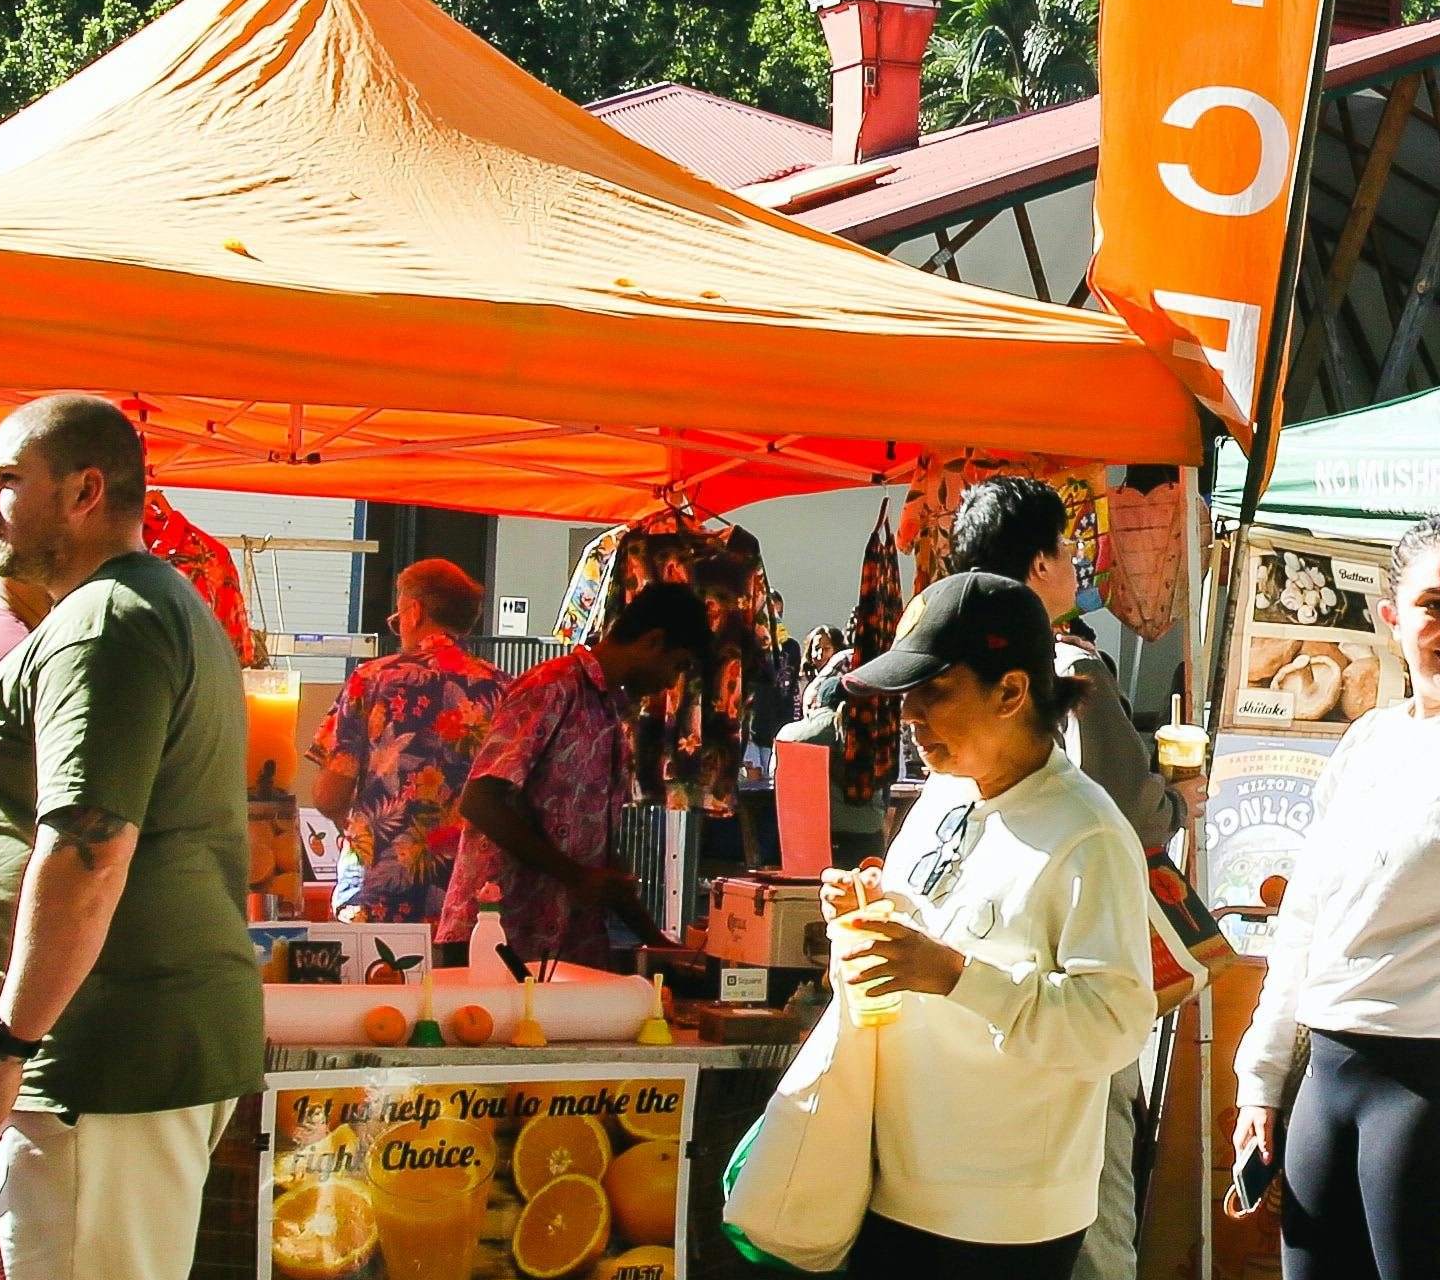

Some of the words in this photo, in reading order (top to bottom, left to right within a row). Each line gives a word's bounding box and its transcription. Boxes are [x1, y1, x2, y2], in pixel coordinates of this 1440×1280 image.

[1313, 460, 1352, 497] NO
[1237, 776, 1298, 797] MILTON
[380, 1090, 442, 1131] help
[449, 1087, 513, 1120] You
[515, 1090, 544, 1117] to
[548, 1086, 631, 1118] make
[636, 1085, 680, 1115] the
[381, 1140, 482, 1172] Choice.
